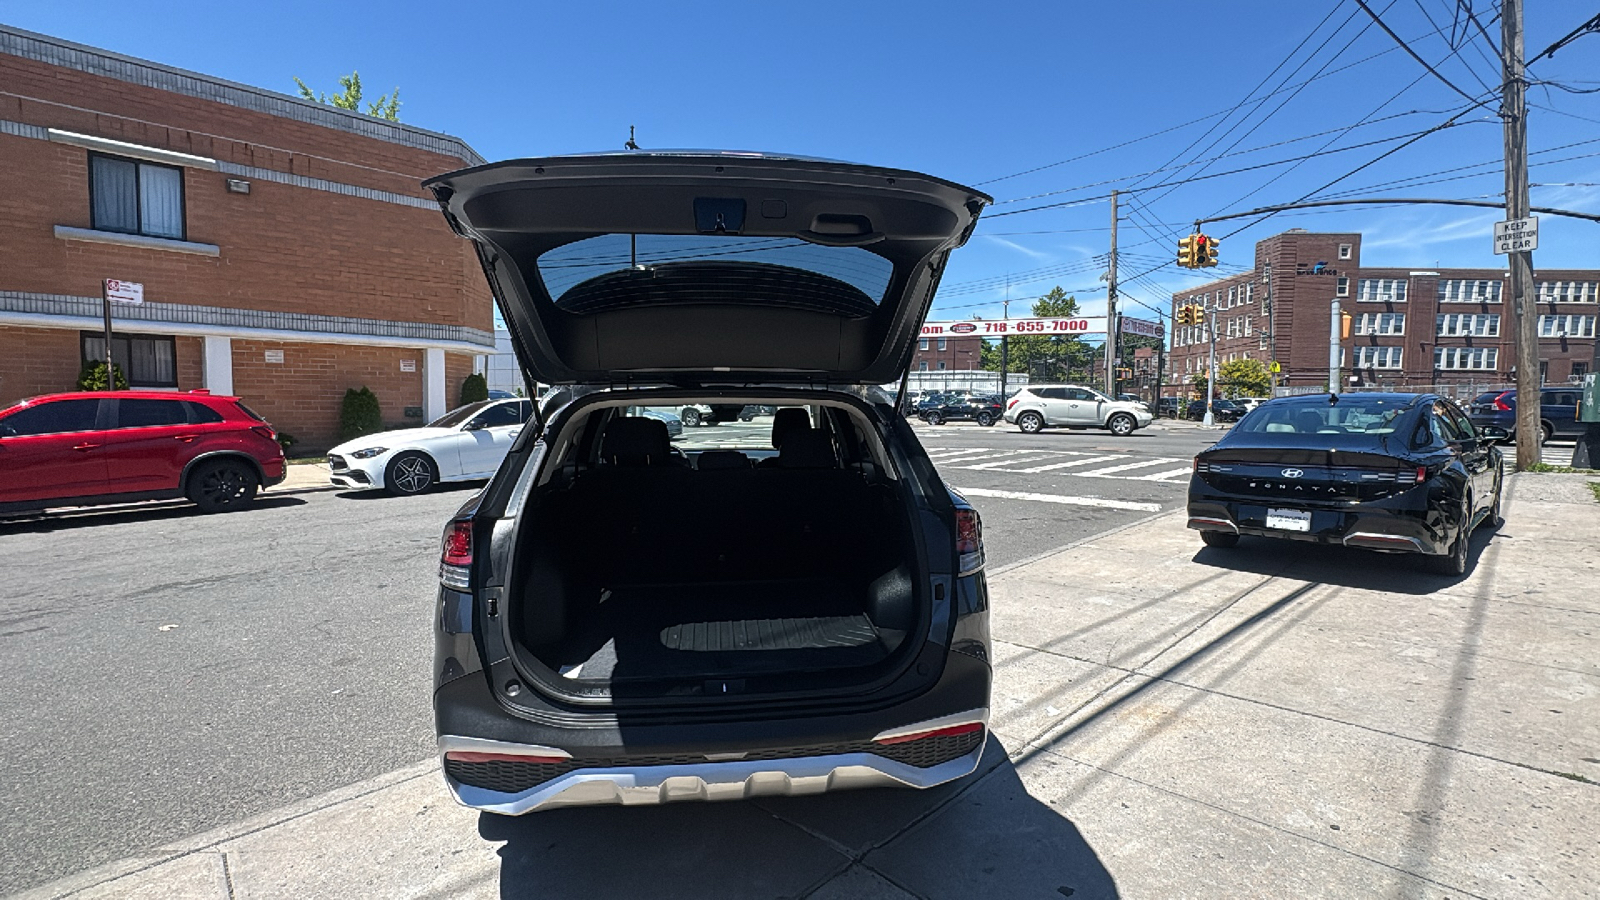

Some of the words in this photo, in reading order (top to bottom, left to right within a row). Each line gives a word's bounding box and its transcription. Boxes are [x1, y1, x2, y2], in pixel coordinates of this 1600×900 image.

[1504, 221, 1528, 232] KEEP
[1496, 230, 1537, 242] INTERSECTION
[1501, 239, 1531, 251] CLEAR
[1249, 482, 1337, 493] SONATA
